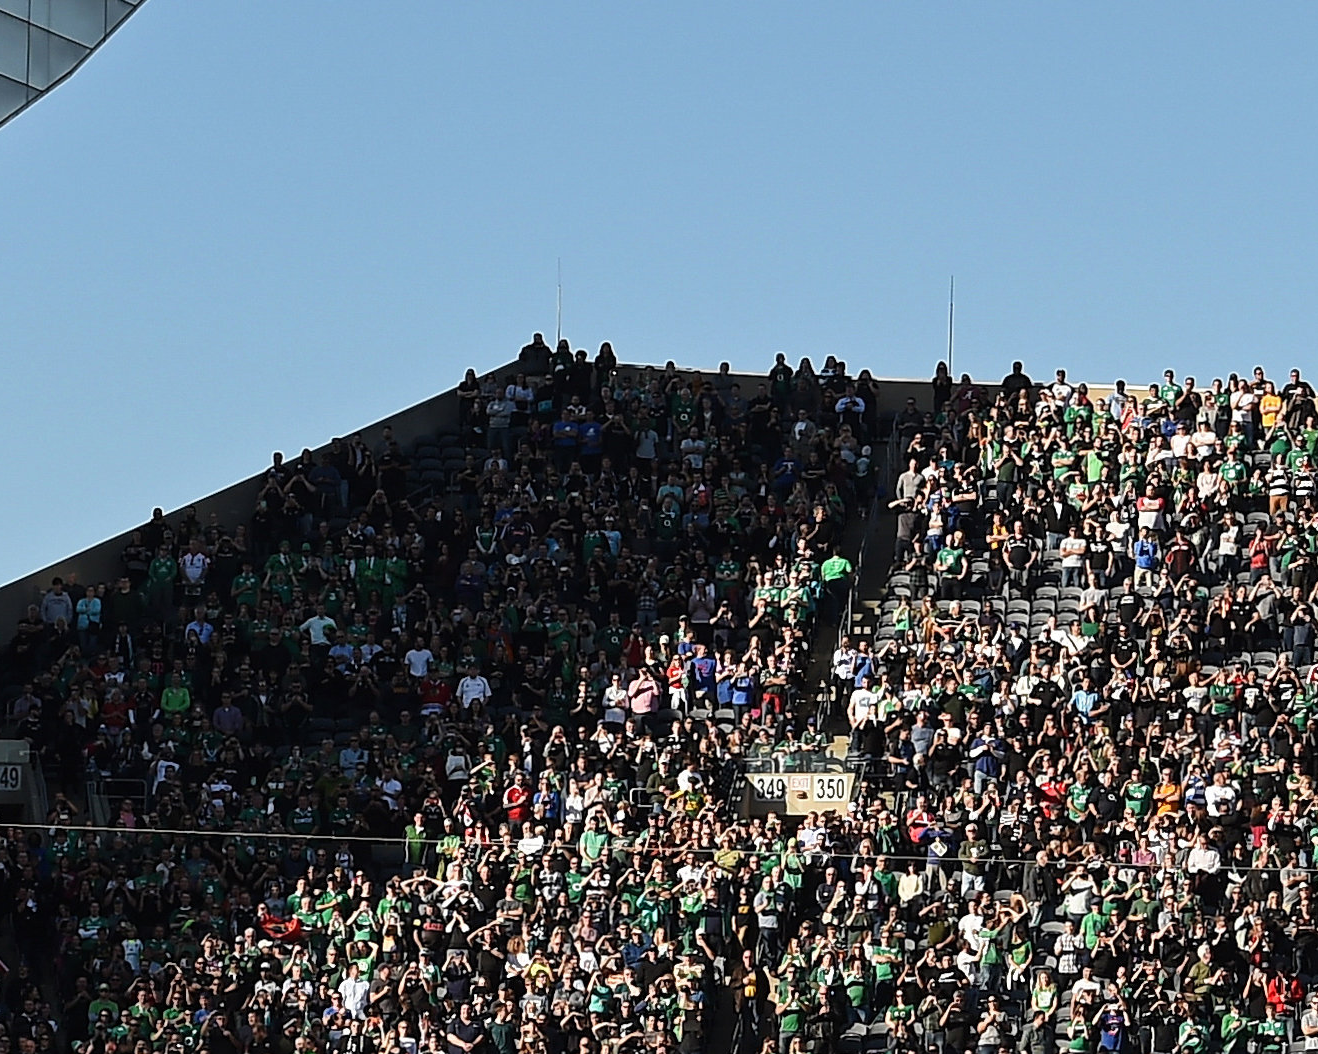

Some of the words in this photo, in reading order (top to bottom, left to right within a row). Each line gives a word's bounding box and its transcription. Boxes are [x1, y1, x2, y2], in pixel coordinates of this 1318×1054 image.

[756, 778, 784, 800] 349
[791, 777, 810, 789] EXIT
[817, 778, 845, 799] 350
